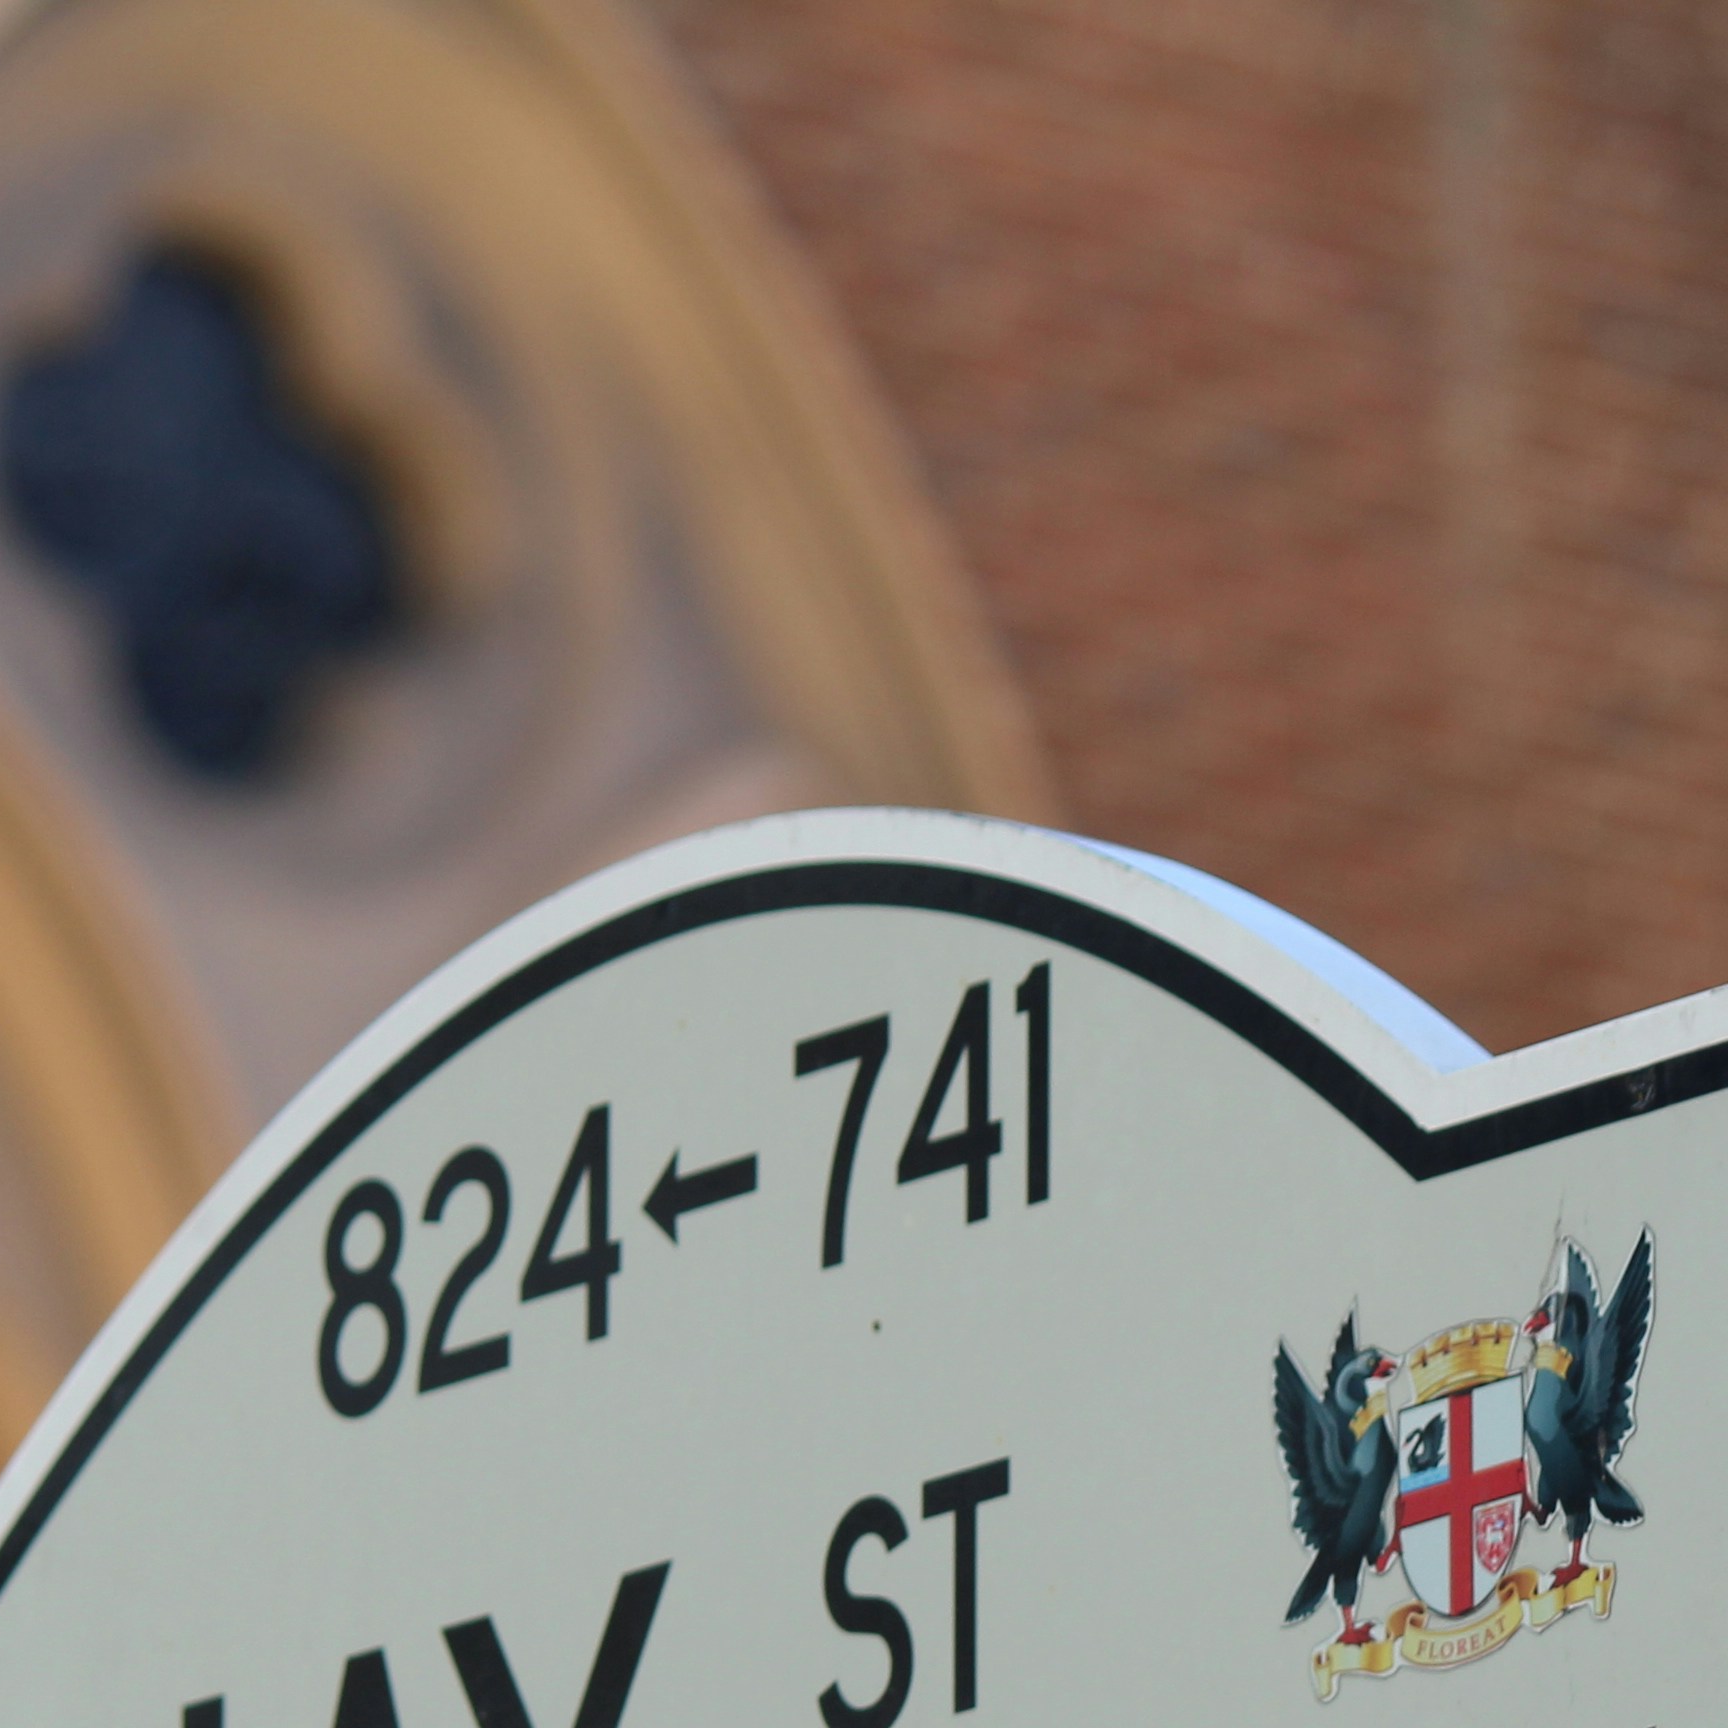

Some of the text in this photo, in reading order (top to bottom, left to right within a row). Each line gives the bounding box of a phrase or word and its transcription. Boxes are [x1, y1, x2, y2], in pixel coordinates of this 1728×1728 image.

[316, 960, 1052, 1420] 824 741
[1415, 1614, 1507, 1660] FLOREAT
